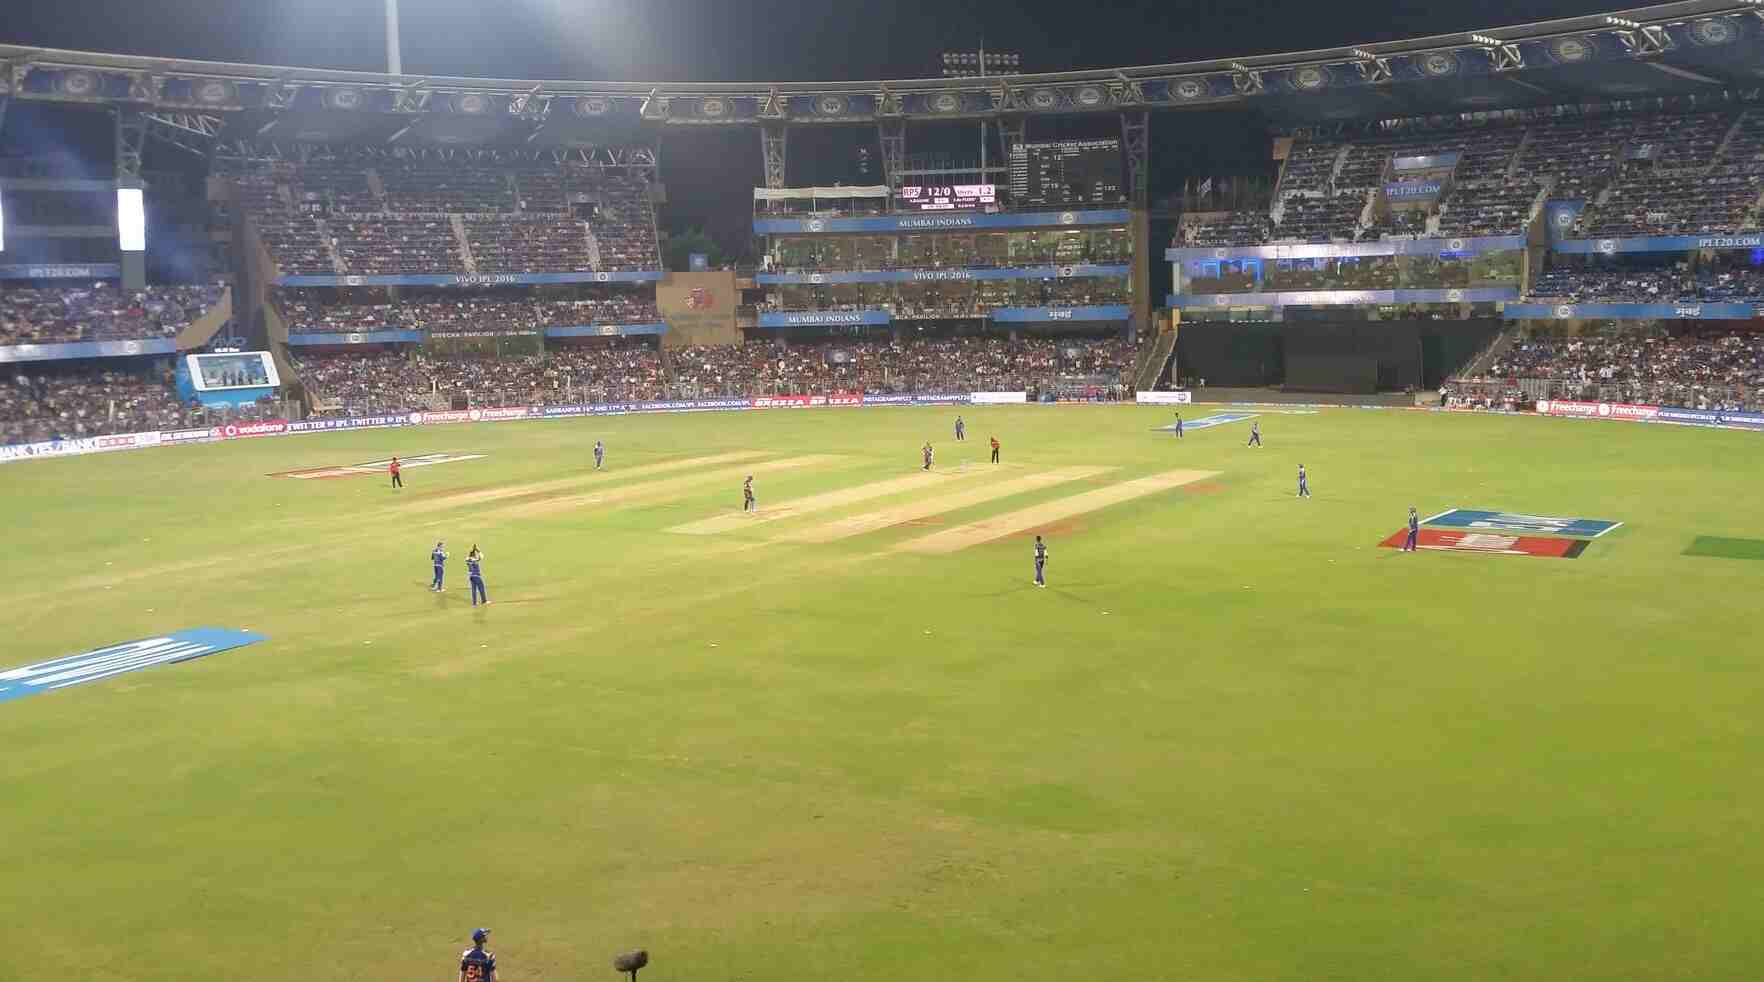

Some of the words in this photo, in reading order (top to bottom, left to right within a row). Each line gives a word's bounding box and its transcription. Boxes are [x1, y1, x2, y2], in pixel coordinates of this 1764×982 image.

[928, 187, 950, 196] 12/0
[899, 218, 935, 228] MUMBAI
[937, 217, 972, 226] INDIANS
[1699, 237, 1761, 248] IPLT20.COM
[913, 272, 934, 280] VIVO
[936, 272, 949, 280] IPL
[789, 315, 825, 324] MUMBAI
[826, 313, 861, 322] INDIANS
[239, 423, 284, 434] vodafone
[287, 421, 325, 431] TWITTER
[352, 417, 385, 426] TWITTER
